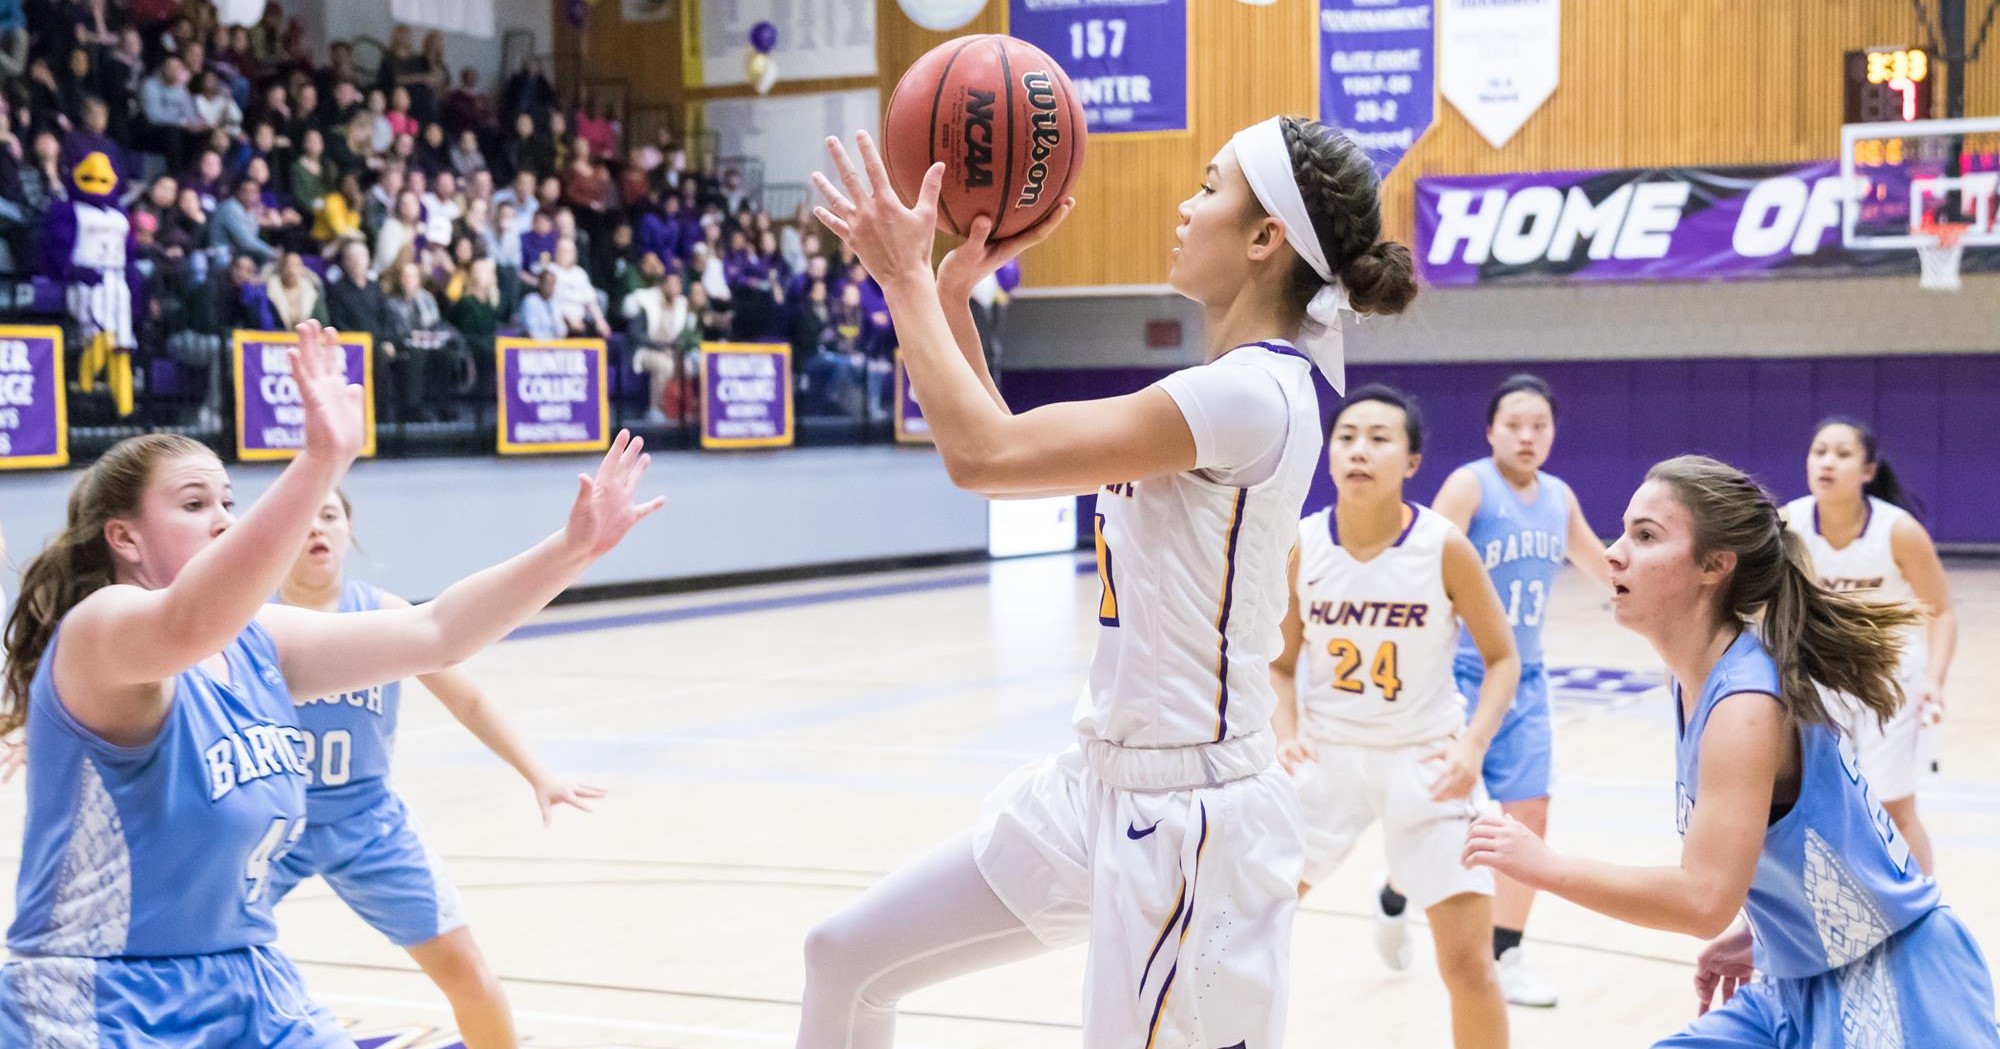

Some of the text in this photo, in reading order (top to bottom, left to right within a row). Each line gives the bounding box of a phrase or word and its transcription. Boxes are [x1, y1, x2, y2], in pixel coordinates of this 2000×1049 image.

[1069, 19, 1127, 60] 157
[1073, 75, 1152, 105] NTER
[964, 88, 996, 188] NCAA
[1015, 70, 1061, 209] Wilson
[1427, 184, 1691, 265] HOME
[1732, 176, 1872, 257] OF
[1483, 529, 1565, 571] BARUC
[1308, 600, 1429, 628] HUNTER
[1506, 578, 1548, 628] 13
[1327, 637, 1402, 702] 24
[205, 722, 307, 803] BARUC
